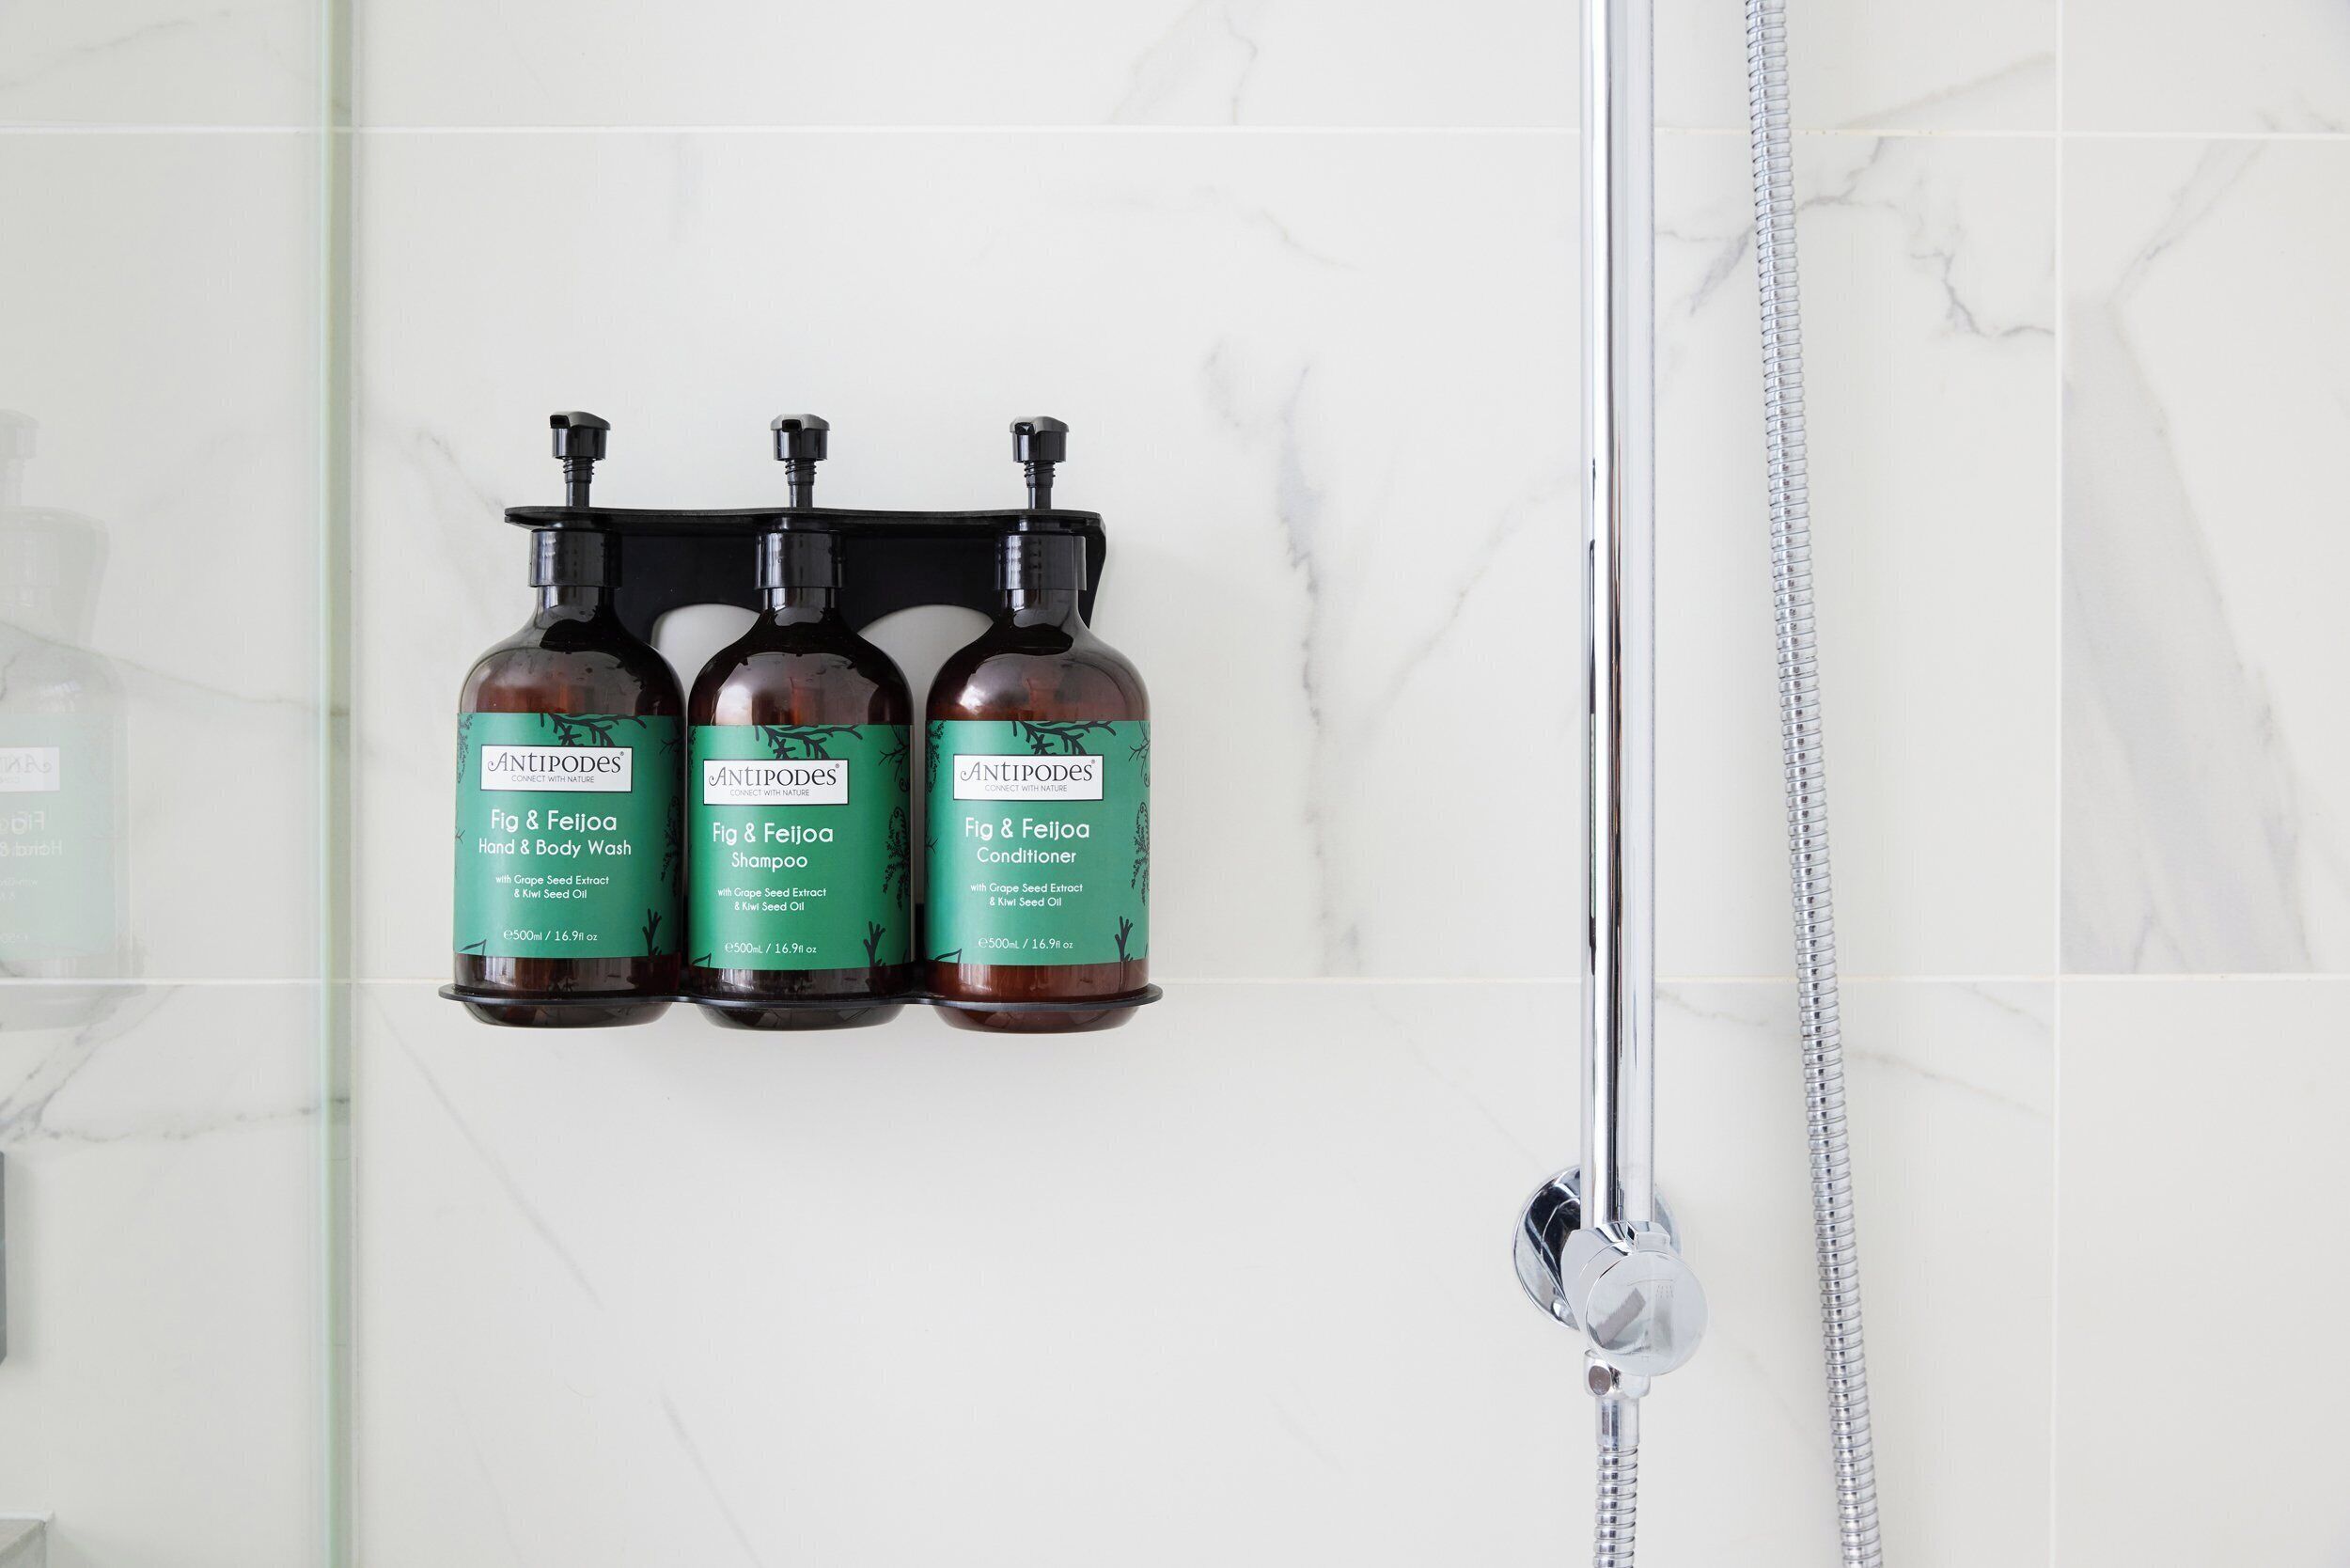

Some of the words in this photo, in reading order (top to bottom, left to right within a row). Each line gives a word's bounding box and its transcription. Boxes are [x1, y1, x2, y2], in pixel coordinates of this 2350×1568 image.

[511, 775, 545, 783] CONNECT
[548, 775, 566, 783] WITH
[567, 775, 595, 783] NATURE
[729, 789, 762, 797] CONNECT
[763, 789, 781, 797] WITH
[782, 789, 810, 797] NATURE
[984, 783, 1019, 792] CONNECT
[1021, 783, 1039, 792] WITH
[1040, 783, 1068, 792] NATURE
[491, 809, 518, 833] Fig
[525, 809, 540, 830] &
[548, 809, 617, 833] Feijoa
[713, 822, 737, 846] Fig
[744, 822, 756, 843] &
[764, 822, 834, 845] Feijoa
[964, 816, 993, 841] Fig
[1000, 818, 1013, 839] &
[1022, 818, 1090, 841] Feijoa
[478, 838, 514, 855] Hand
[520, 839, 530, 855] &
[536, 839, 581, 858] Body
[588, 839, 632, 855] Wash
[977, 847, 1076, 864] Conditioner
[731, 852, 808, 872] Shampoo
[495, 874, 512, 885] with
[513, 874, 544, 886] Grape
[547, 875, 572, 885] Seed
[575, 875, 609, 885] Extract
[513, 888, 520, 899] &
[523, 888, 541, 899] Kiwi
[543, 888, 570, 899] Seed
[572, 888, 588, 899] Oil
[717, 887, 732, 897] with
[733, 887, 762, 900] Grape
[764, 887, 790, 897] Seed
[792, 887, 827, 897] Extract
[970, 883, 987, 892] with
[989, 883, 1019, 895] Grape
[1022, 883, 1048, 893] Seed
[1050, 884, 1084, 893] Extract
[734, 902, 741, 912] &
[742, 902, 760, 912] Kiwi
[761, 902, 787, 912] Seed
[790, 902, 805, 912] Oil
[989, 897, 995, 907] &
[997, 897, 1016, 907] Kiwi
[1018, 897, 1044, 907] Seed
[1047, 897, 1062, 907] Oil
[544, 930, 552, 941] /
[555, 930, 584, 941] 16.9fl
[765, 942, 772, 954] /
[775, 942, 804, 954] 16.9fl
[1022, 938, 1029, 949] /
[1032, 938, 1060, 949] 16.9fl
